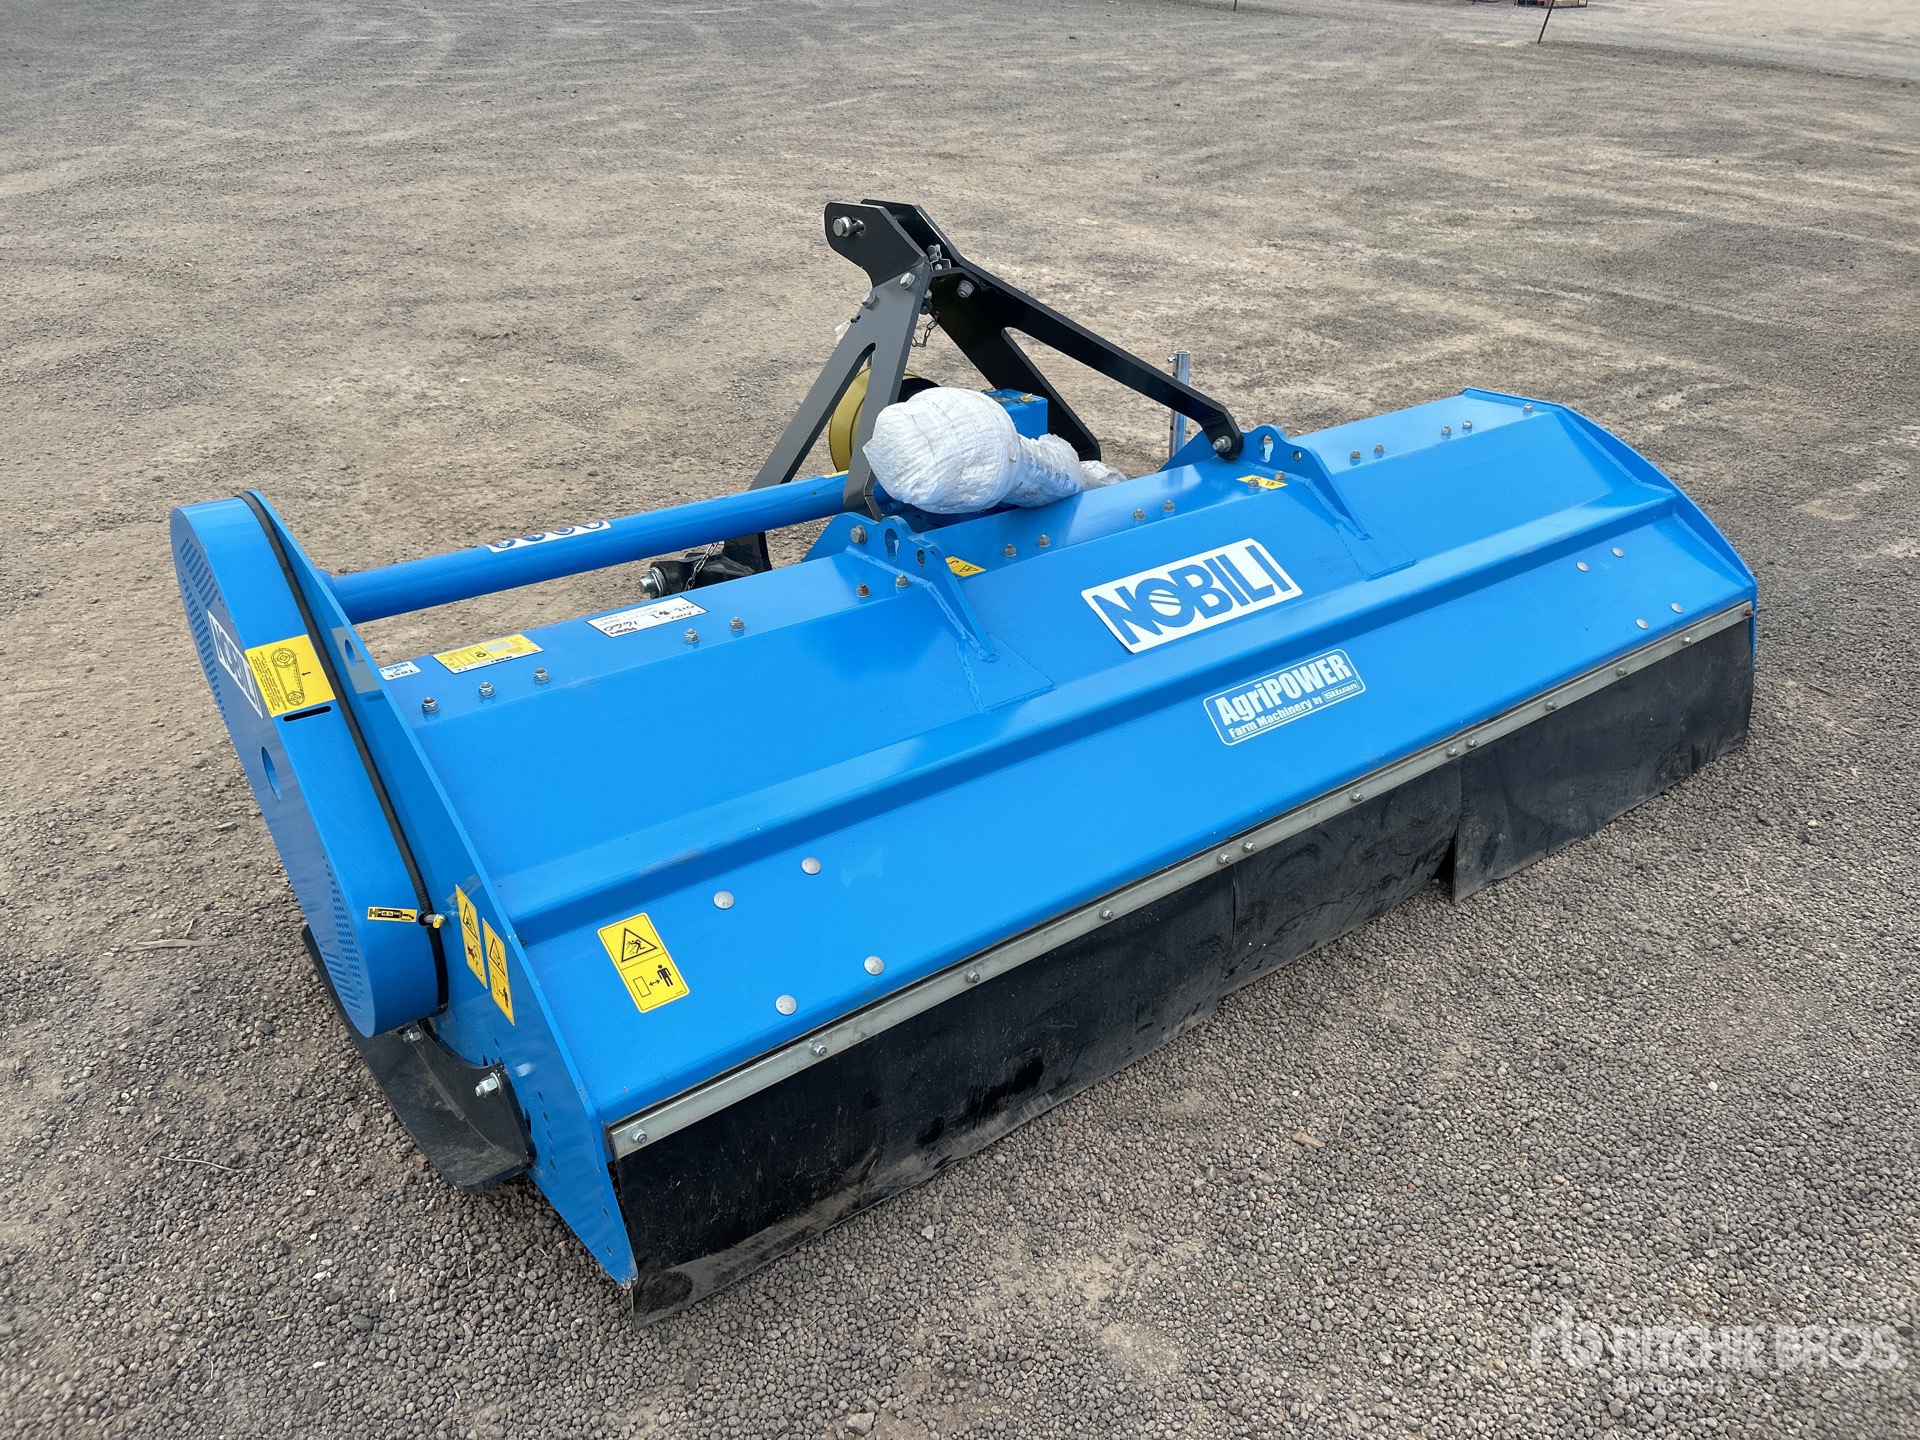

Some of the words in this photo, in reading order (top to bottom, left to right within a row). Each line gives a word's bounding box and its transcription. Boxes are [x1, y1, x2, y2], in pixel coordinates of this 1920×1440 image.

[1091, 544, 1292, 645] NOBILI
[1215, 654, 1353, 726] AgriPOWER
[1228, 721, 1258, 739] Farm
[1257, 698, 1314, 728] Machinery
[1313, 695, 1323, 706] by
